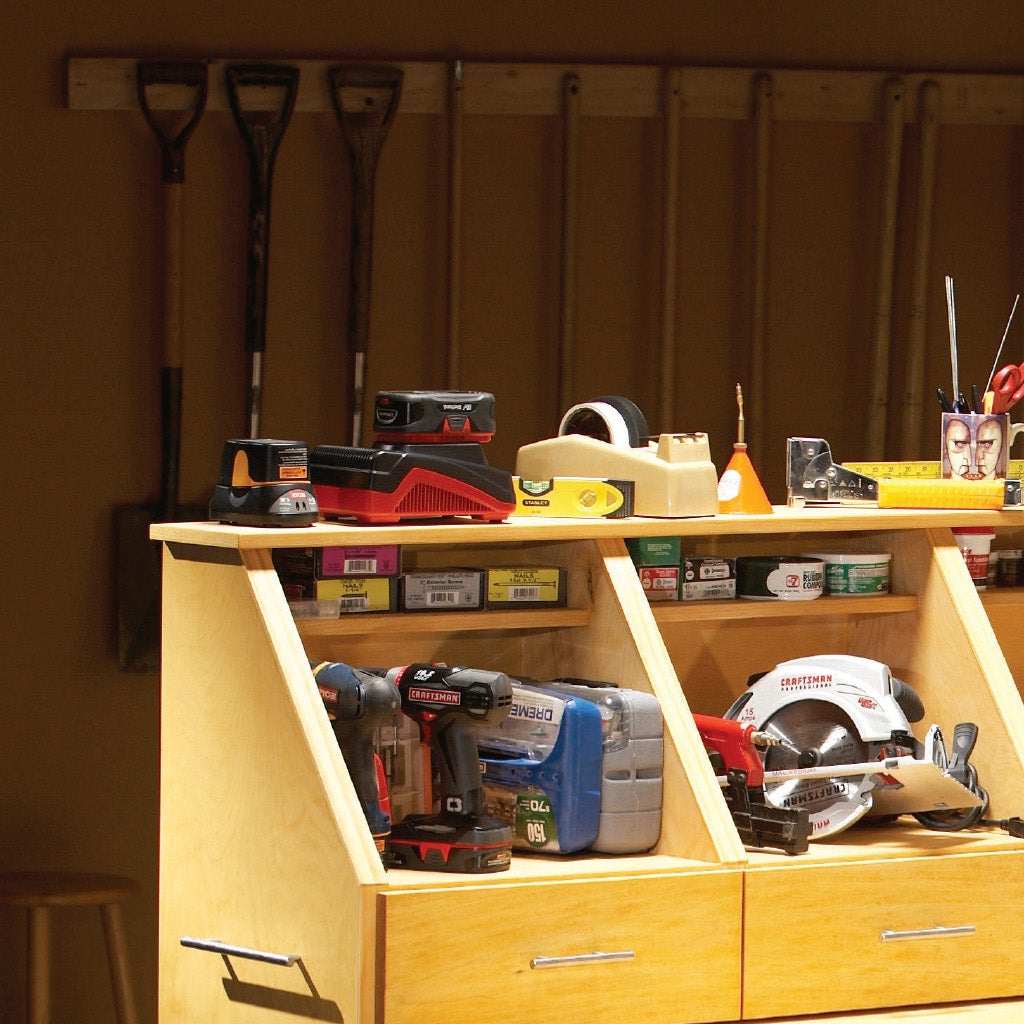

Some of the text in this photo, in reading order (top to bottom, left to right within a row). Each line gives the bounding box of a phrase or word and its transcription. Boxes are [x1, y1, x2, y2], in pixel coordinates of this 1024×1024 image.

[780, 674, 833, 687] CRAFTSMAN
[780, 683, 832, 691] PROFESSIONAL
[411, 690, 459, 703] CRAFTSMAN
[510, 703, 553, 722] DREME
[771, 768, 817, 776] MAGNESIUM
[783, 783, 846, 808] CRAFTSMAN
[527, 823, 547, 843] 150
